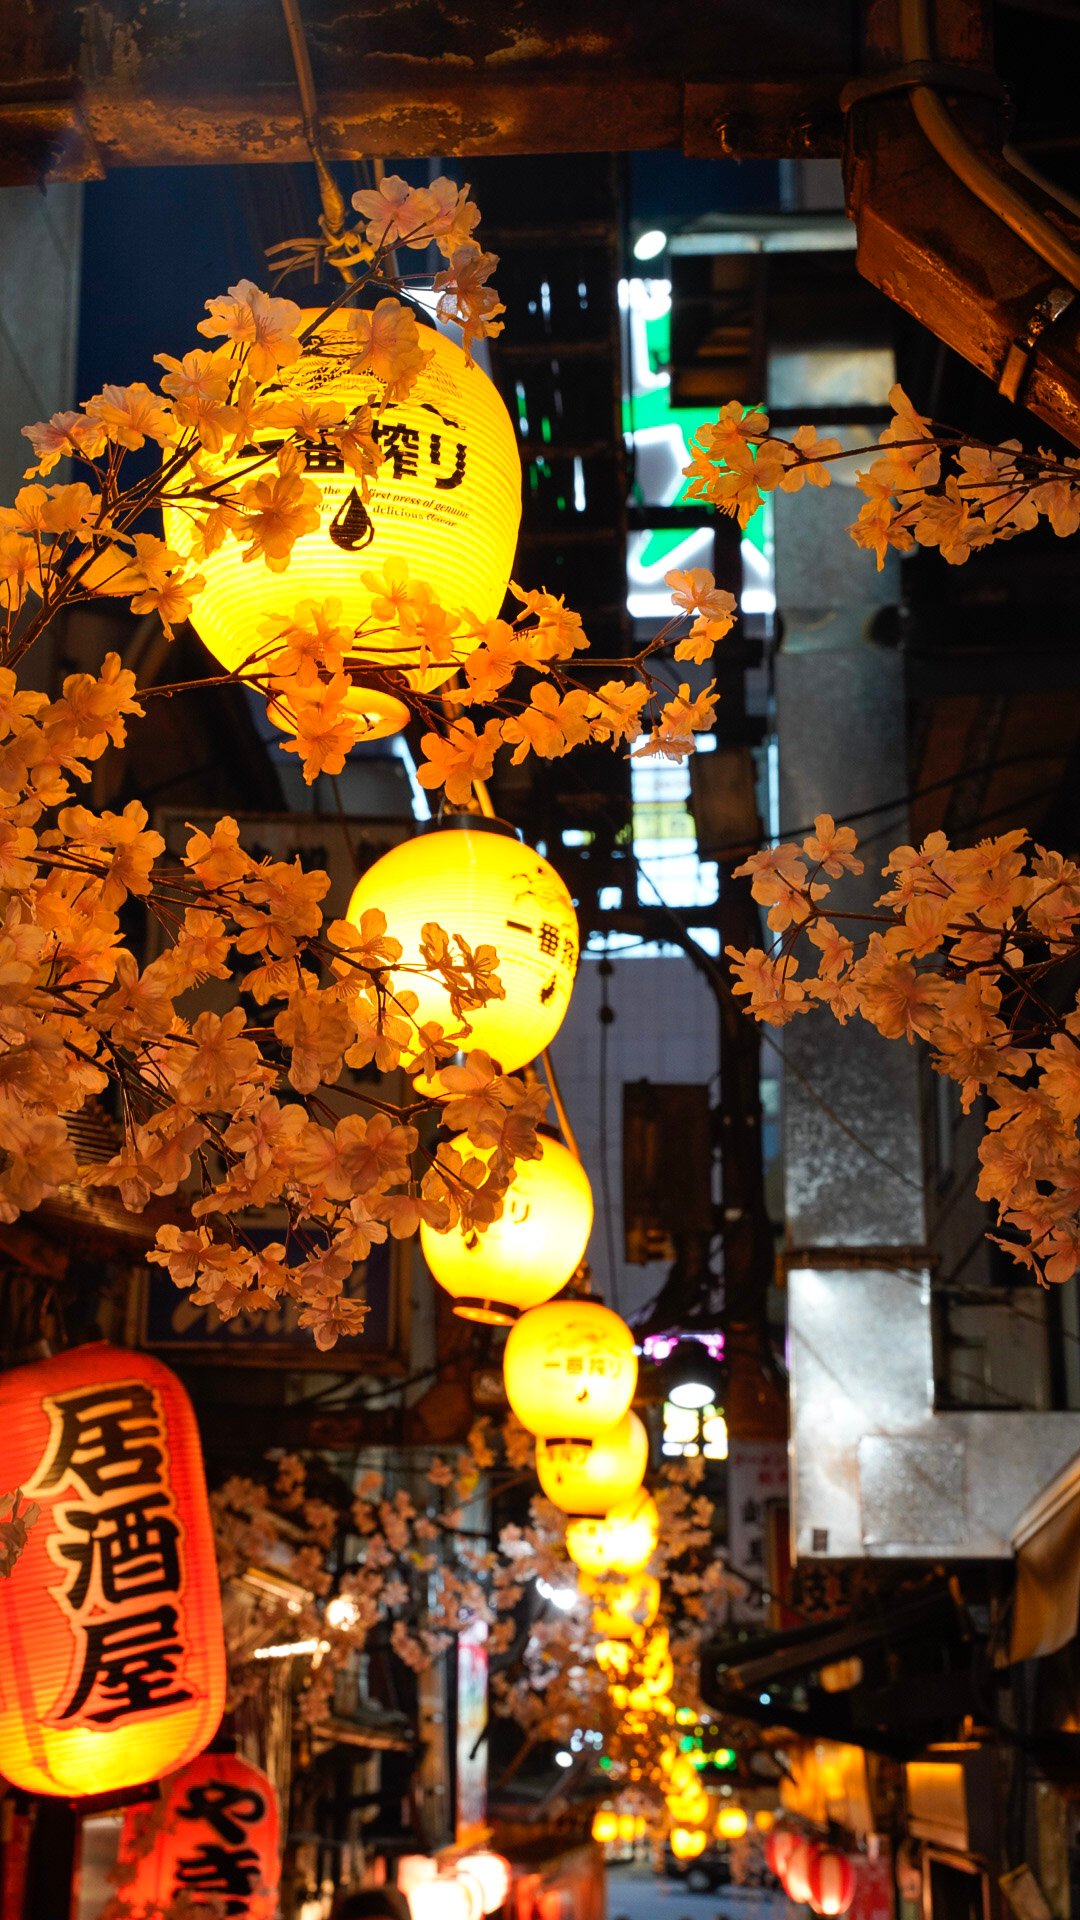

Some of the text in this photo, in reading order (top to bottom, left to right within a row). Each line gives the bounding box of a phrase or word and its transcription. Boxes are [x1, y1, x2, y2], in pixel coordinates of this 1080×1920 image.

[323, 485, 341, 495] the
[393, 494, 420, 506] press
[422, 499, 435, 509] of
[372, 504, 424, 520] delicious
[38, 1384, 194, 1723] 居酒屋
